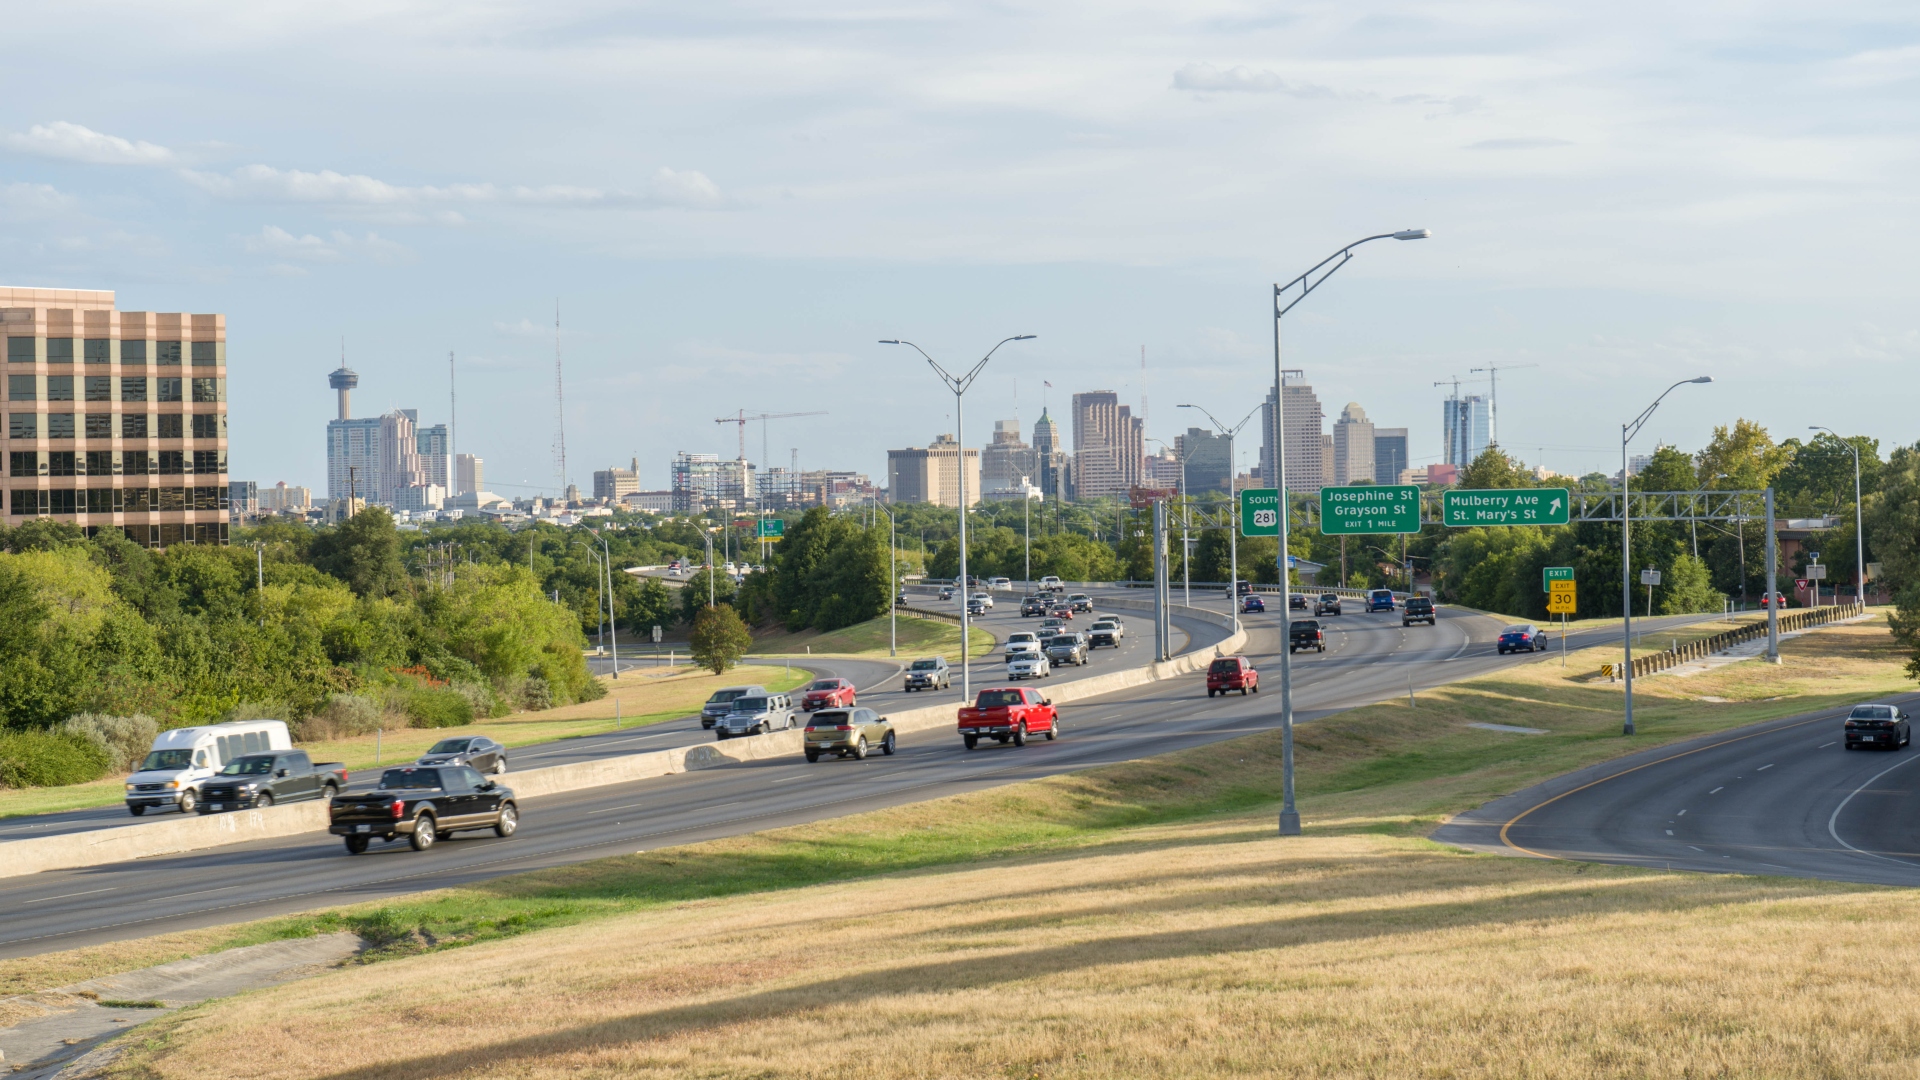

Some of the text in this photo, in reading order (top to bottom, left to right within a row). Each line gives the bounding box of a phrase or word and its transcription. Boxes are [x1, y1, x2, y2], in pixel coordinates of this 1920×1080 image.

[1328, 490, 1413, 503] Josephine St
[1451, 496, 1539, 508] Mulberry Ave
[1335, 504, 1406, 518] Grayson St
[1453, 509, 1537, 522] St. Mary's St
[1255, 513, 1275, 523] 281
[1367, 520, 1373, 528] 1
[1555, 594, 1572, 604] 30
